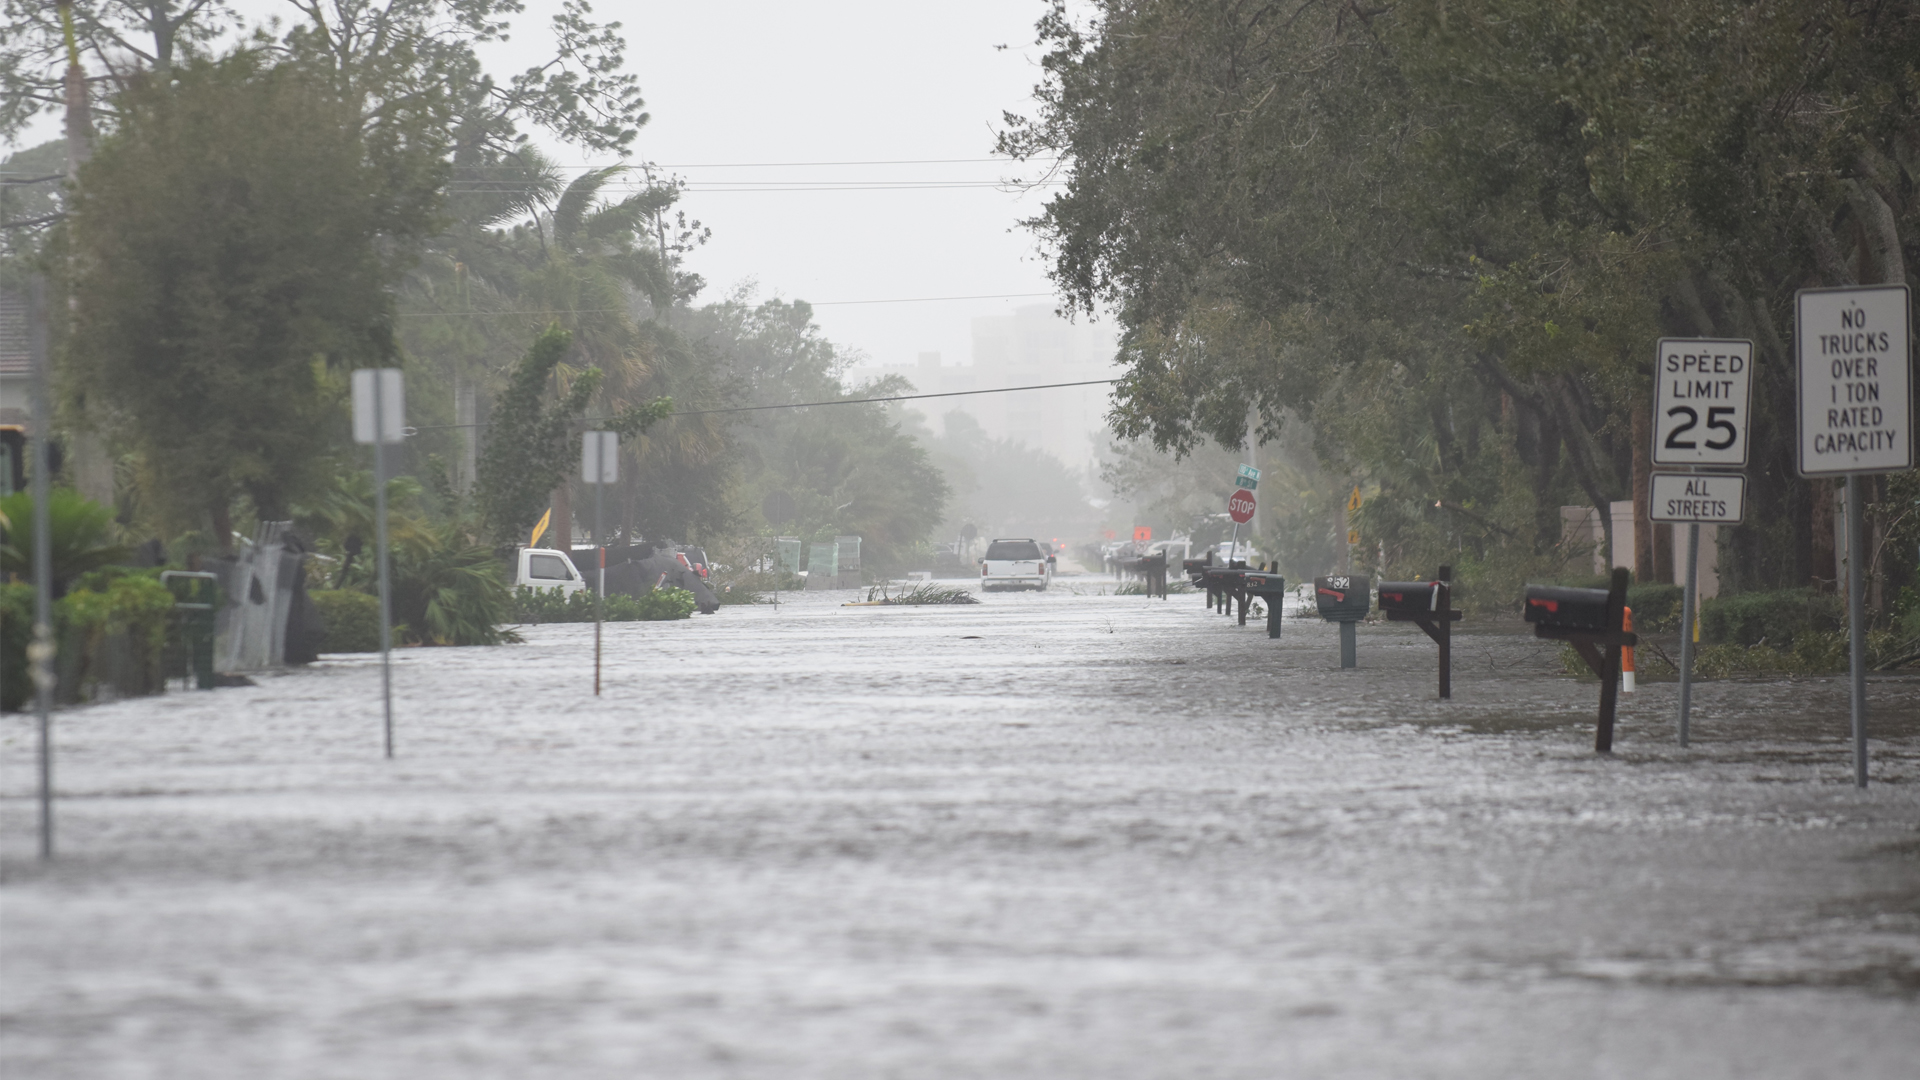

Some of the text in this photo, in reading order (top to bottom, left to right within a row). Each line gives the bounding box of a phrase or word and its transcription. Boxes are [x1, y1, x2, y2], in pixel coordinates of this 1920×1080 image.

[1842, 309, 1865, 329] NO
[1820, 332, 1889, 355] TRUCKS
[1667, 354, 1743, 373] SPEED
[1832, 358, 1878, 379] OVER
[1674, 381, 1733, 399] LIMIT
[1832, 382, 1879, 403] 1 TON
[1828, 407, 1883, 428] RATED
[1665, 406, 1737, 450] 25
[1814, 430, 1896, 454] CAPACITY
[1685, 480, 1710, 496] ALL
[1230, 498, 1254, 514] STOP
[1667, 500, 1726, 517] STREETS
